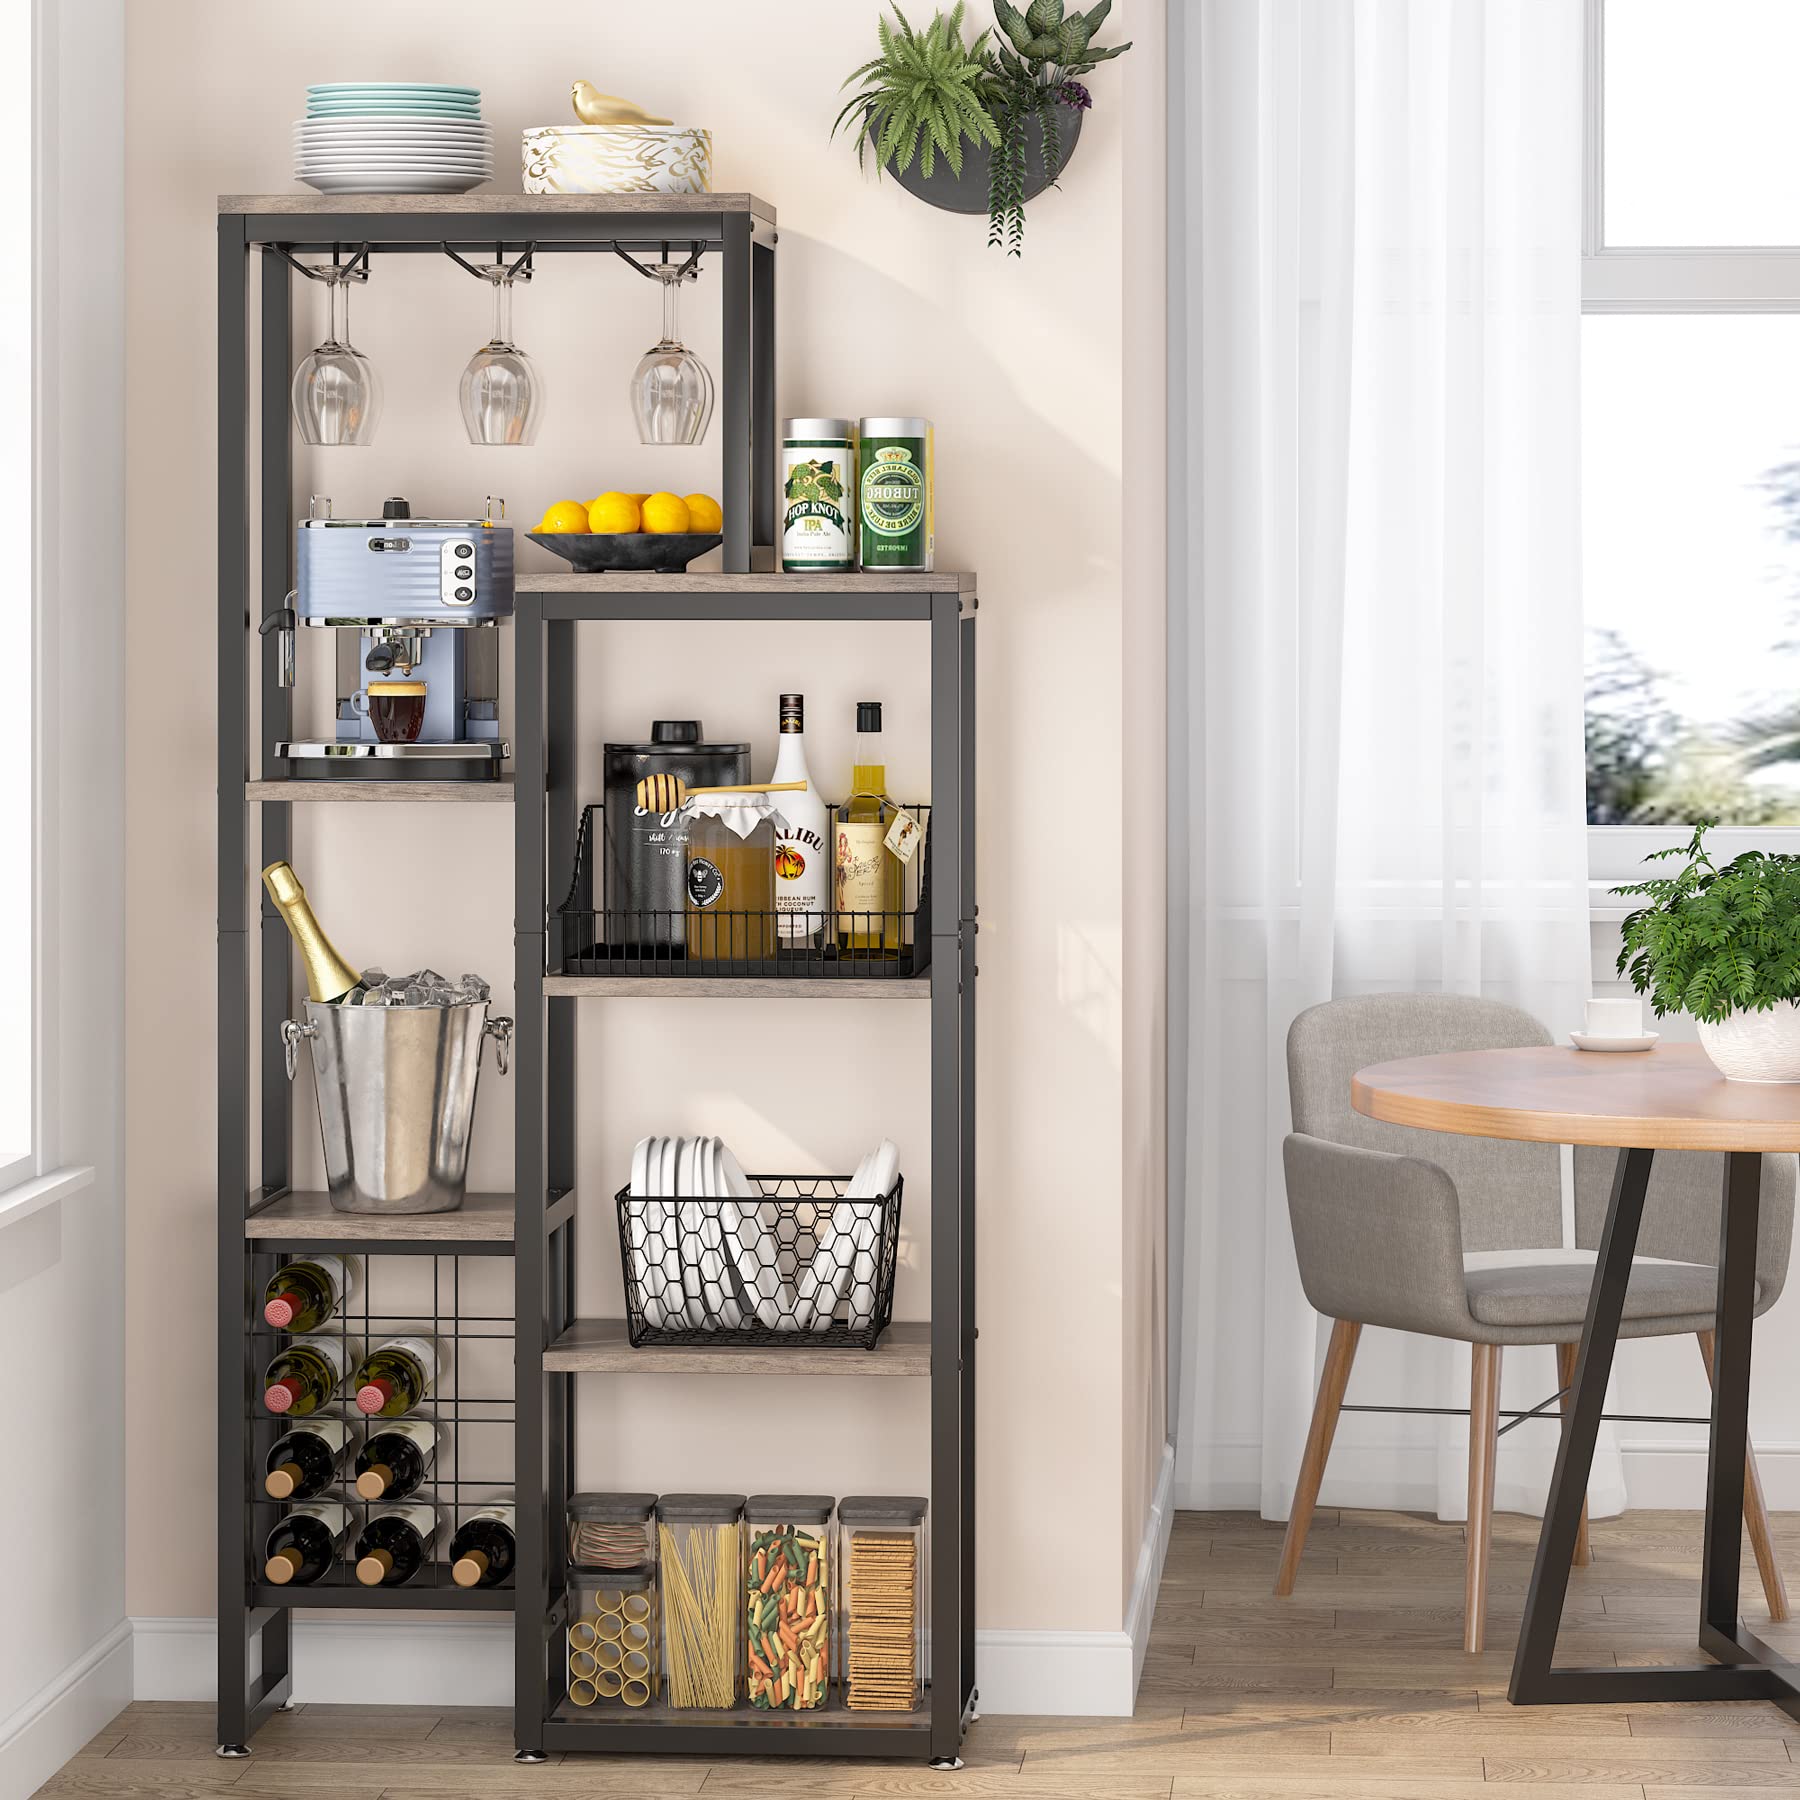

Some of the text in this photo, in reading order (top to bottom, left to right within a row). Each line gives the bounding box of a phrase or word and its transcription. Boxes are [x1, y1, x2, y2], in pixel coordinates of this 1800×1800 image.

[789, 502, 838, 521] HOP KNOT
[804, 519, 823, 531] IPA
